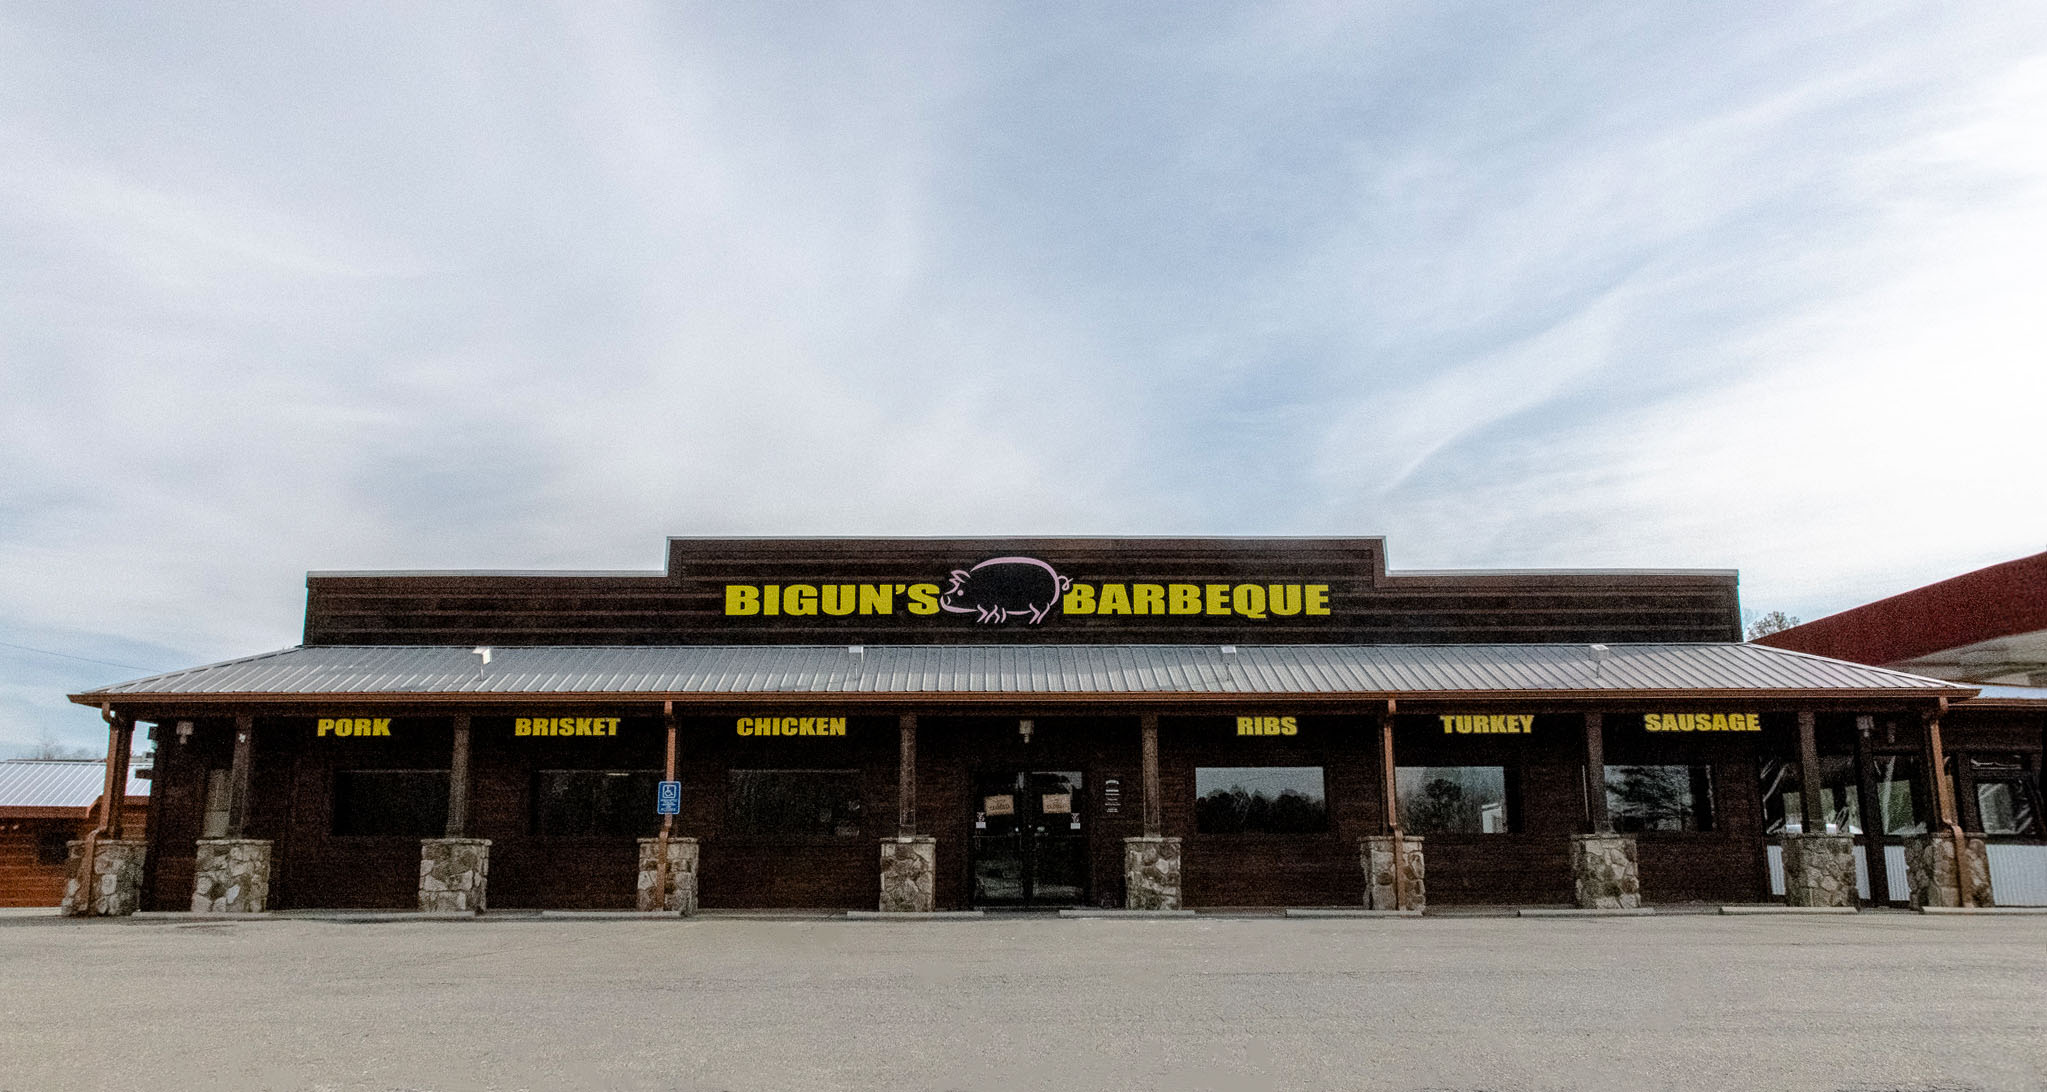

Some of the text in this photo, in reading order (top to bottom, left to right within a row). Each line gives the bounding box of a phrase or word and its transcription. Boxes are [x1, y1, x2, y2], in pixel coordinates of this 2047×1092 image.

[725, 583, 1331, 618] BIGUN'S BARBEQUE
[318, 718, 391, 737] PORK
[515, 717, 621, 737] BRISKET
[736, 717, 847, 737] CHICKEN
[1236, 716, 1299, 736] RIBS
[1439, 714, 1534, 734] TURKEY
[1644, 713, 1761, 732] SAUSAGE
